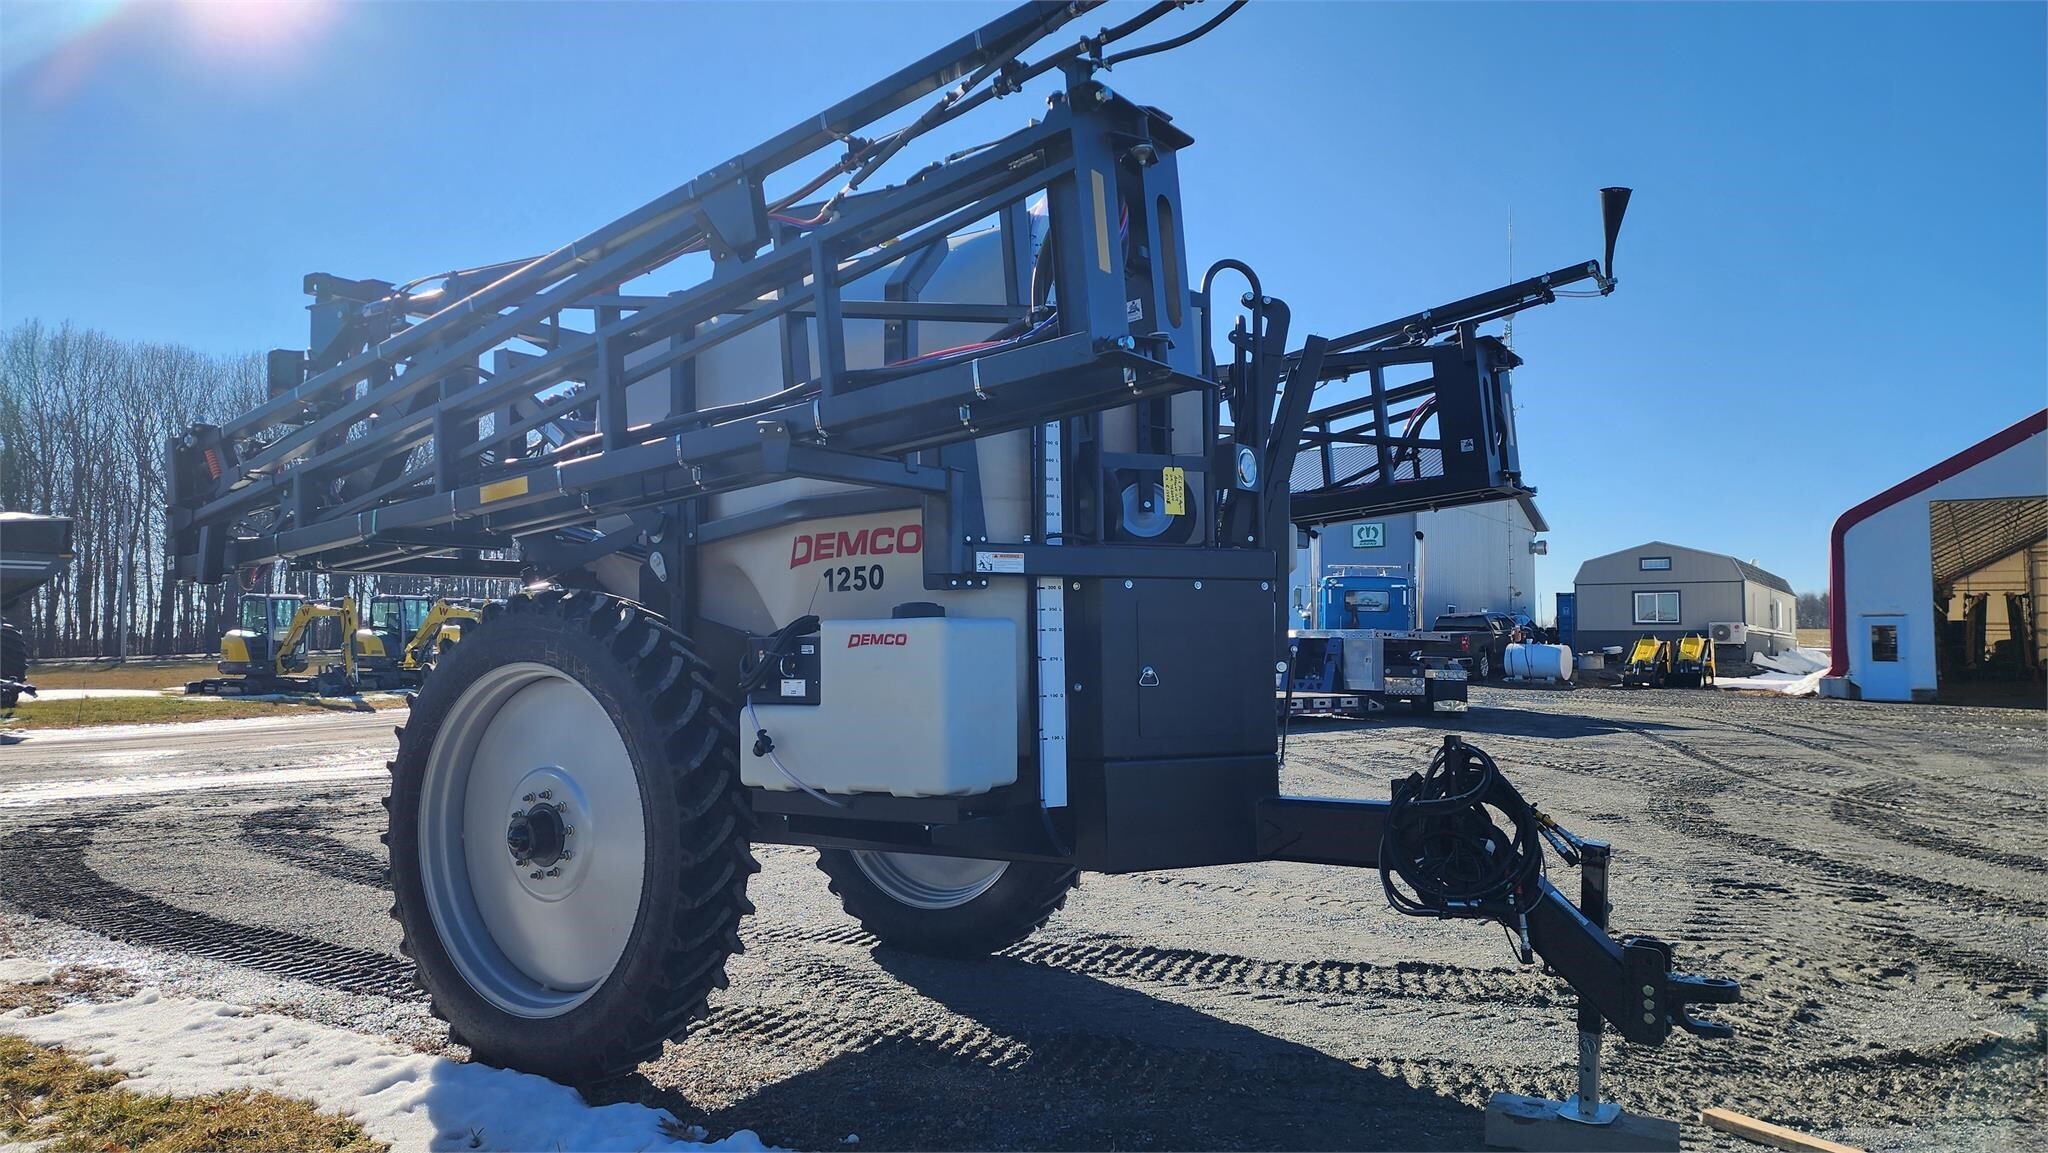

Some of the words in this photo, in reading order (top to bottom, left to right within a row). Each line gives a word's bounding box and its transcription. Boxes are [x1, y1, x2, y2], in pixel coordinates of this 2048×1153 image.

[790, 524, 922, 569] DEMCO
[823, 563, 884, 592] 1250
[847, 633, 907, 648] DEMCO
